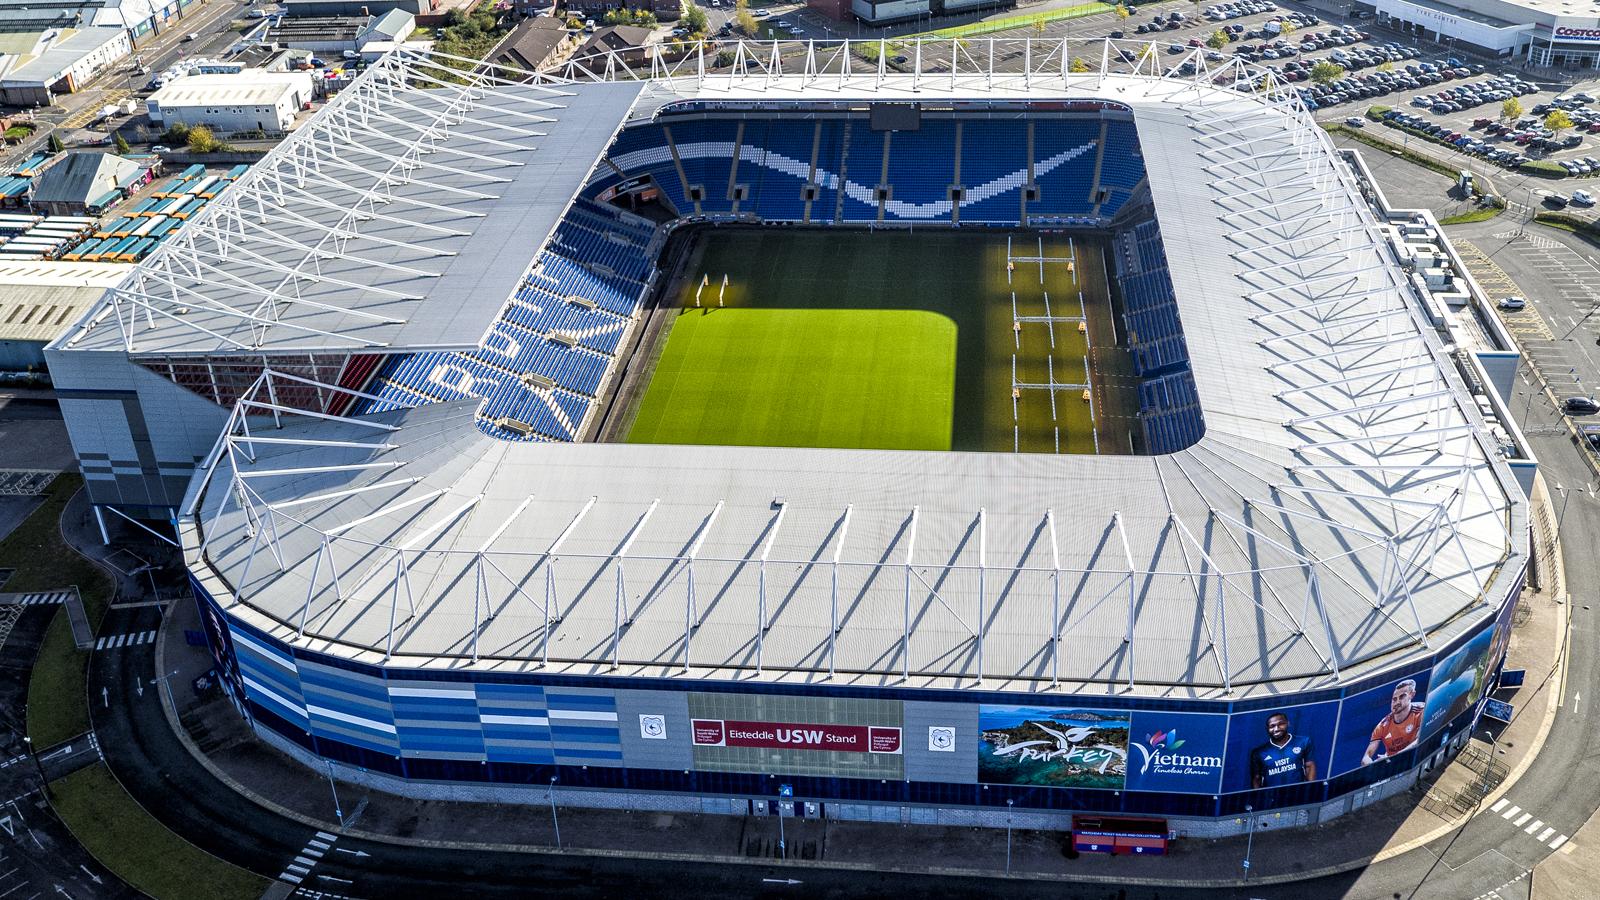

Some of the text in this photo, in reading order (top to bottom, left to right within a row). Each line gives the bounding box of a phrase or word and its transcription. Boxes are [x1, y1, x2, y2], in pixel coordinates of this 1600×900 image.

[1555, 26, 1600, 37] COSTCO
[729, 729, 857, 744] Eisteddle USW Stand
[1130, 742, 1222, 775] Vietnam
[1274, 757, 1290, 767] VISIT
[1153, 765, 1210, 776] Timeless Charm
[1268, 763, 1297, 776] MALAYSIA
